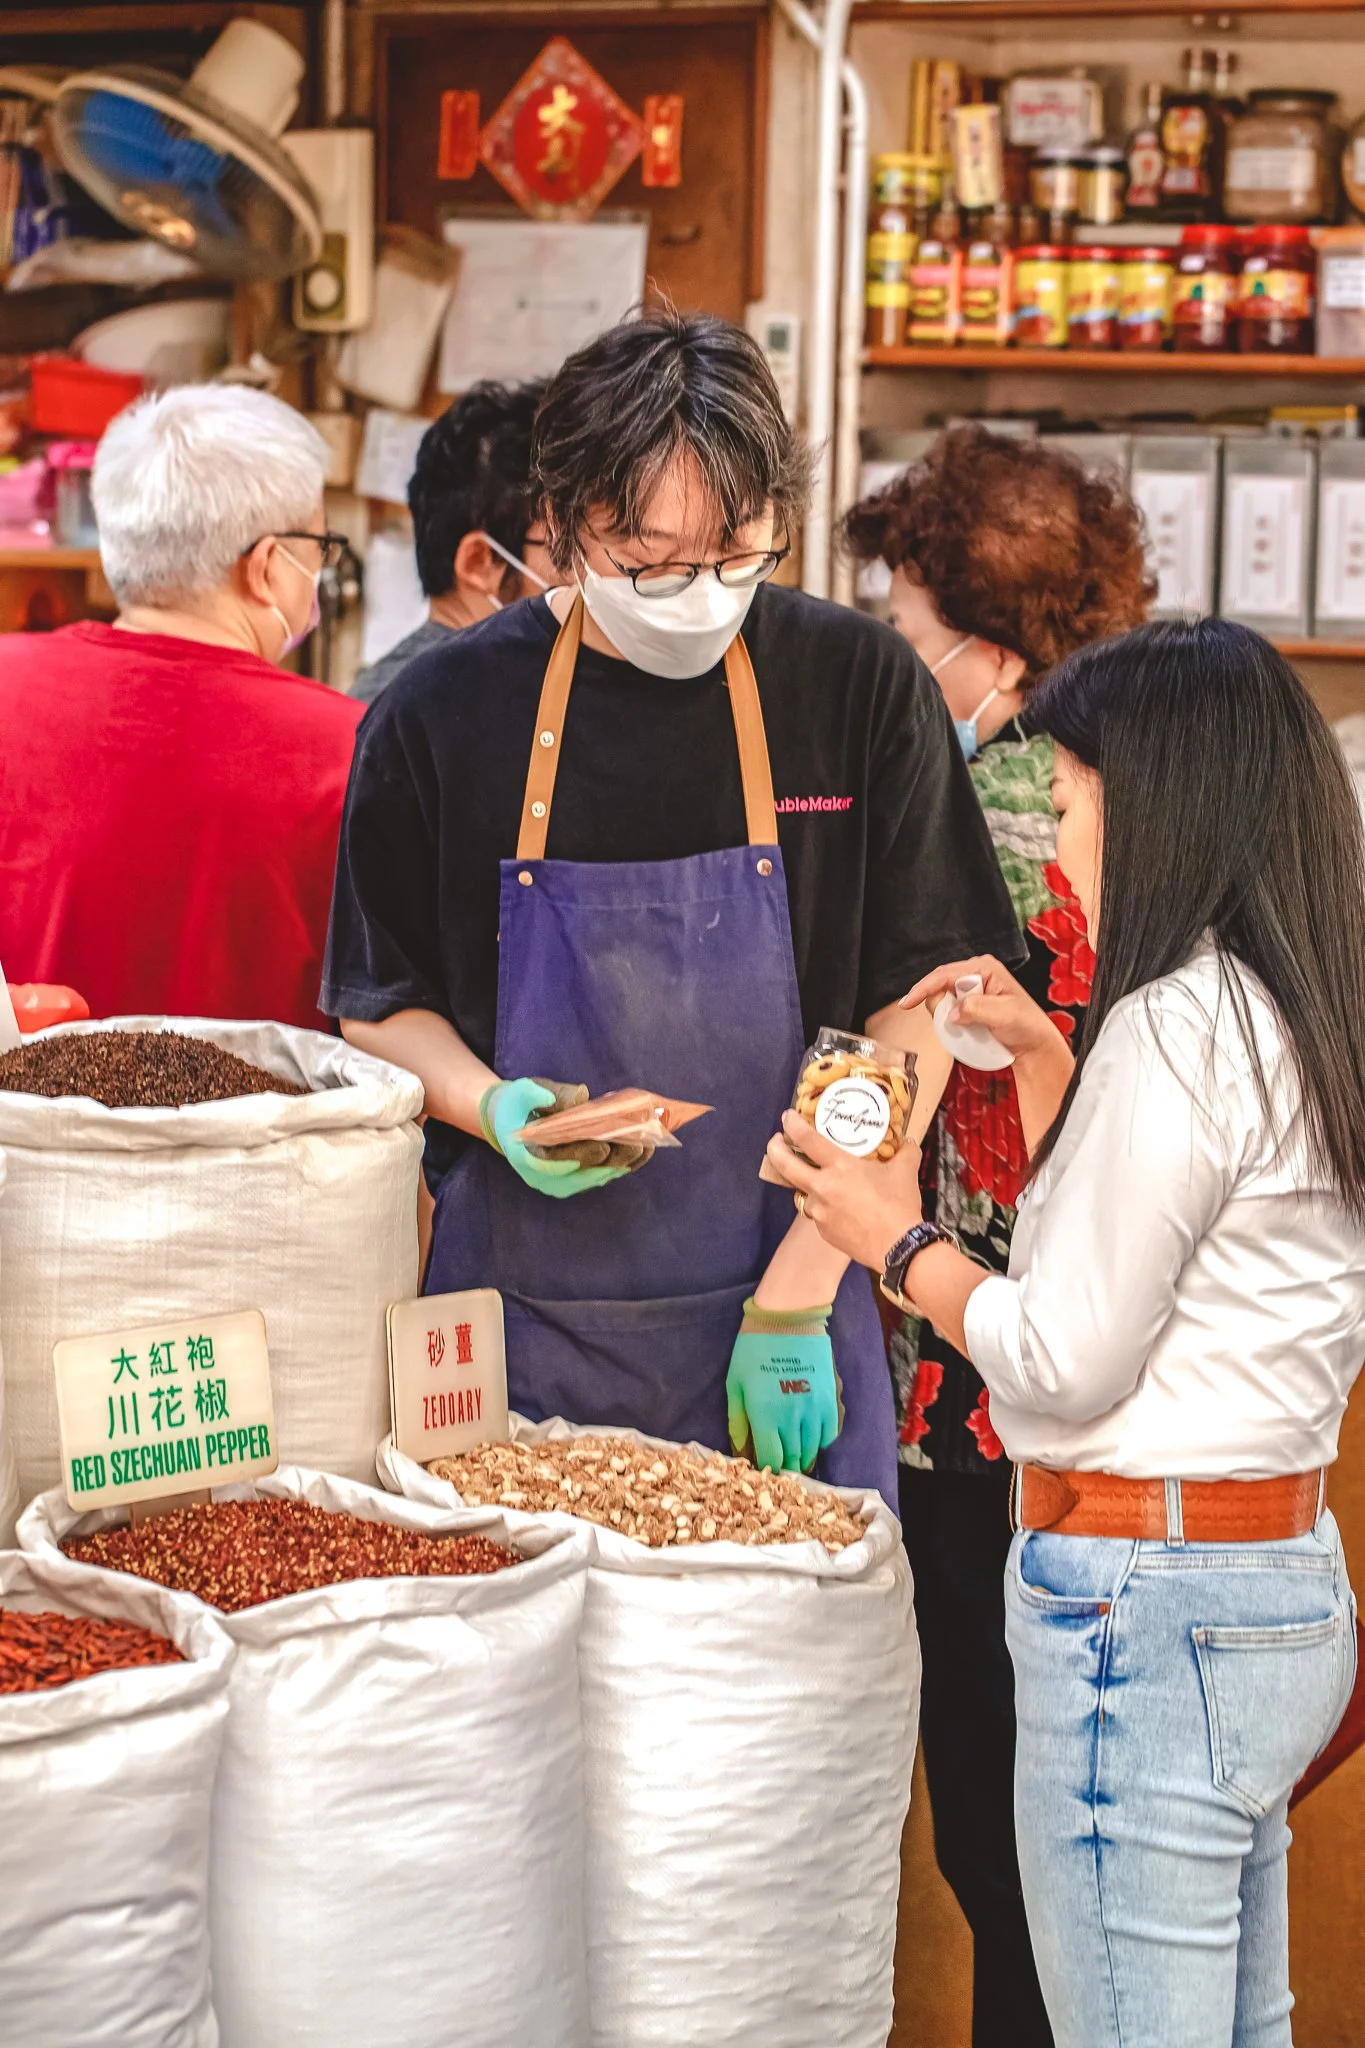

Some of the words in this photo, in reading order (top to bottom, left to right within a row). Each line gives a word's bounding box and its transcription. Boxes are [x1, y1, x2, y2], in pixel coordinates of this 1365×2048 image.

[110, 1333, 216, 1384] 大紅袍
[426, 1322, 474, 1368] 砂薑
[108, 1378, 230, 1440] 川花椒
[422, 1387, 482, 1430] ZEDOARY
[779, 1379, 811, 1395] 3M
[71, 1453, 107, 1493] RED
[109, 1436, 202, 1486] SZECHUAN
[205, 1424, 272, 1468] PEPPER
